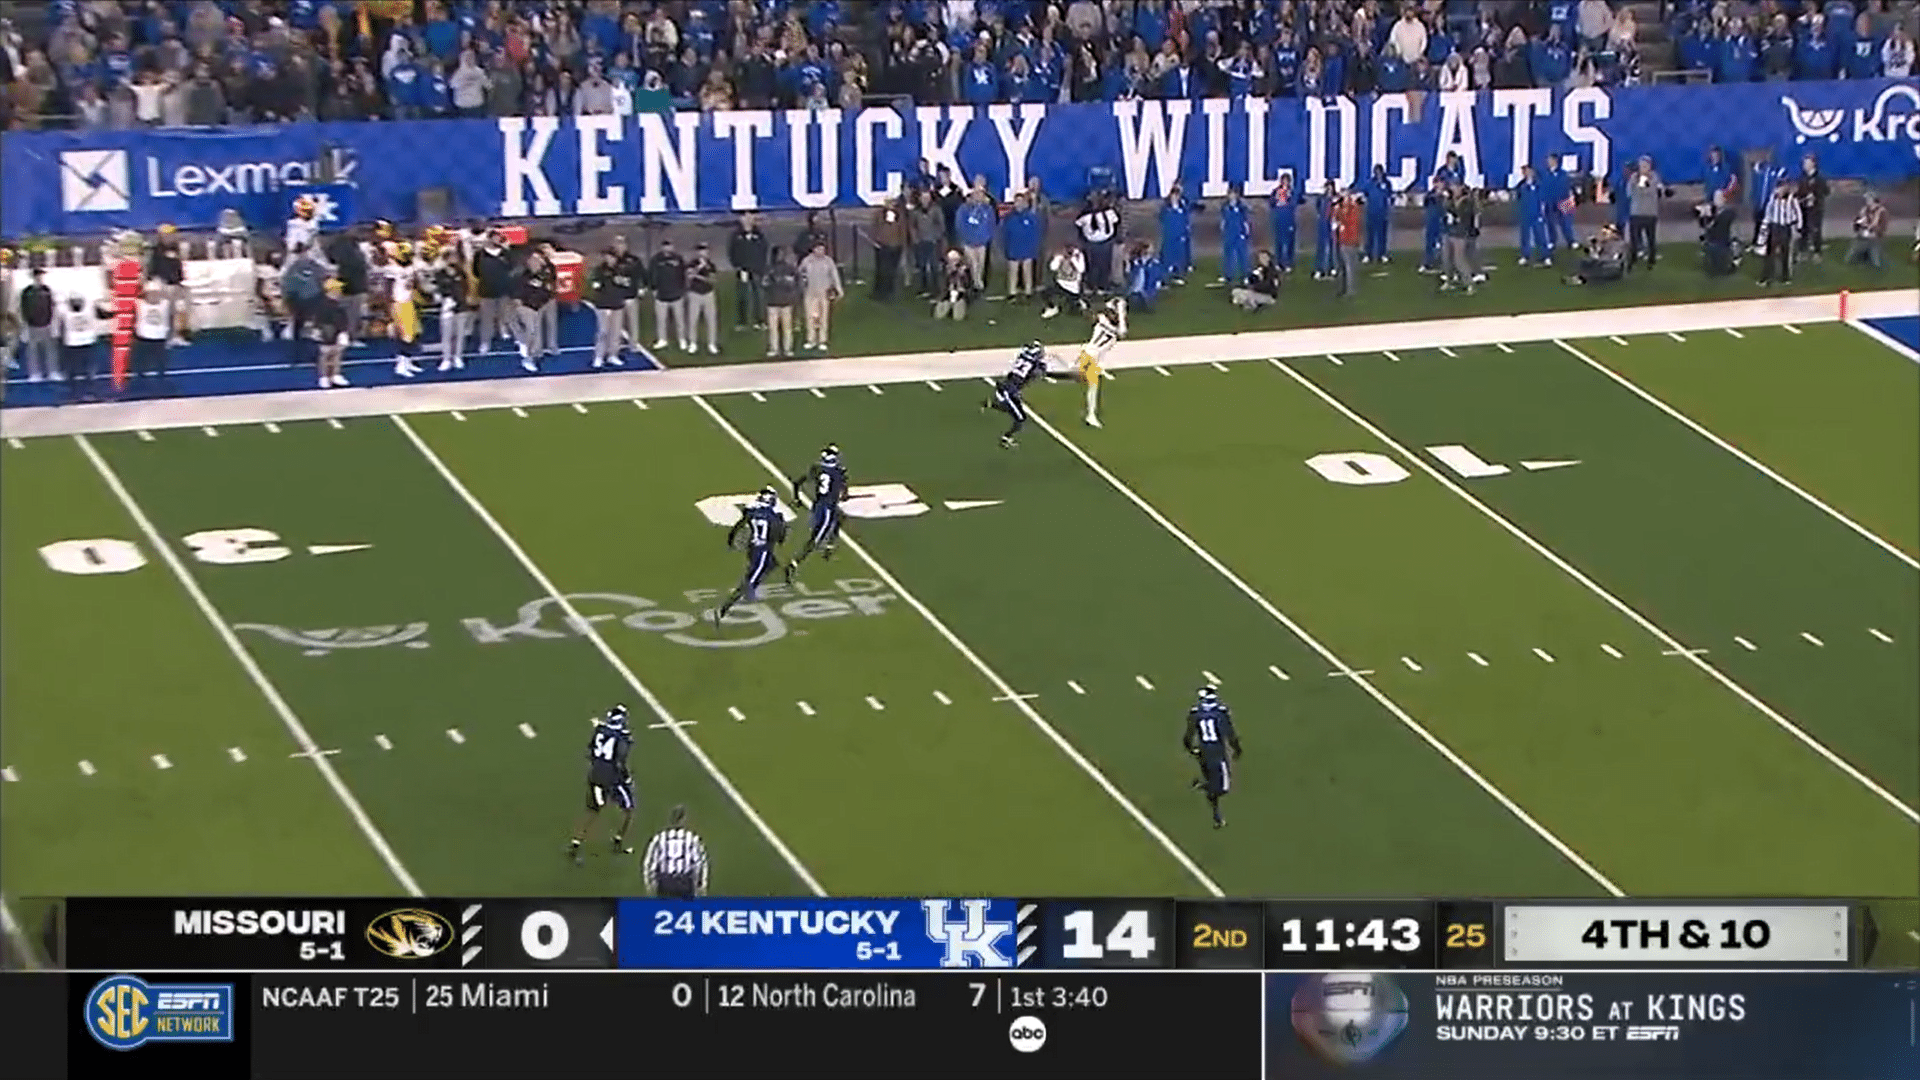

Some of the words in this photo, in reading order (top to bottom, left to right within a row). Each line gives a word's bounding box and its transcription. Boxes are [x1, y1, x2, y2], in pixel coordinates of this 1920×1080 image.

[146, 147, 359, 196] Lexmak
[500, 104, 1046, 217] KENTUCKY
[1113, 87, 1611, 200] WILDCATS
[818, 474, 831, 495] 3
[459, 592, 898, 649] Kroger
[592, 732, 616, 761] 54
[1199, 718, 1218, 742] 11
